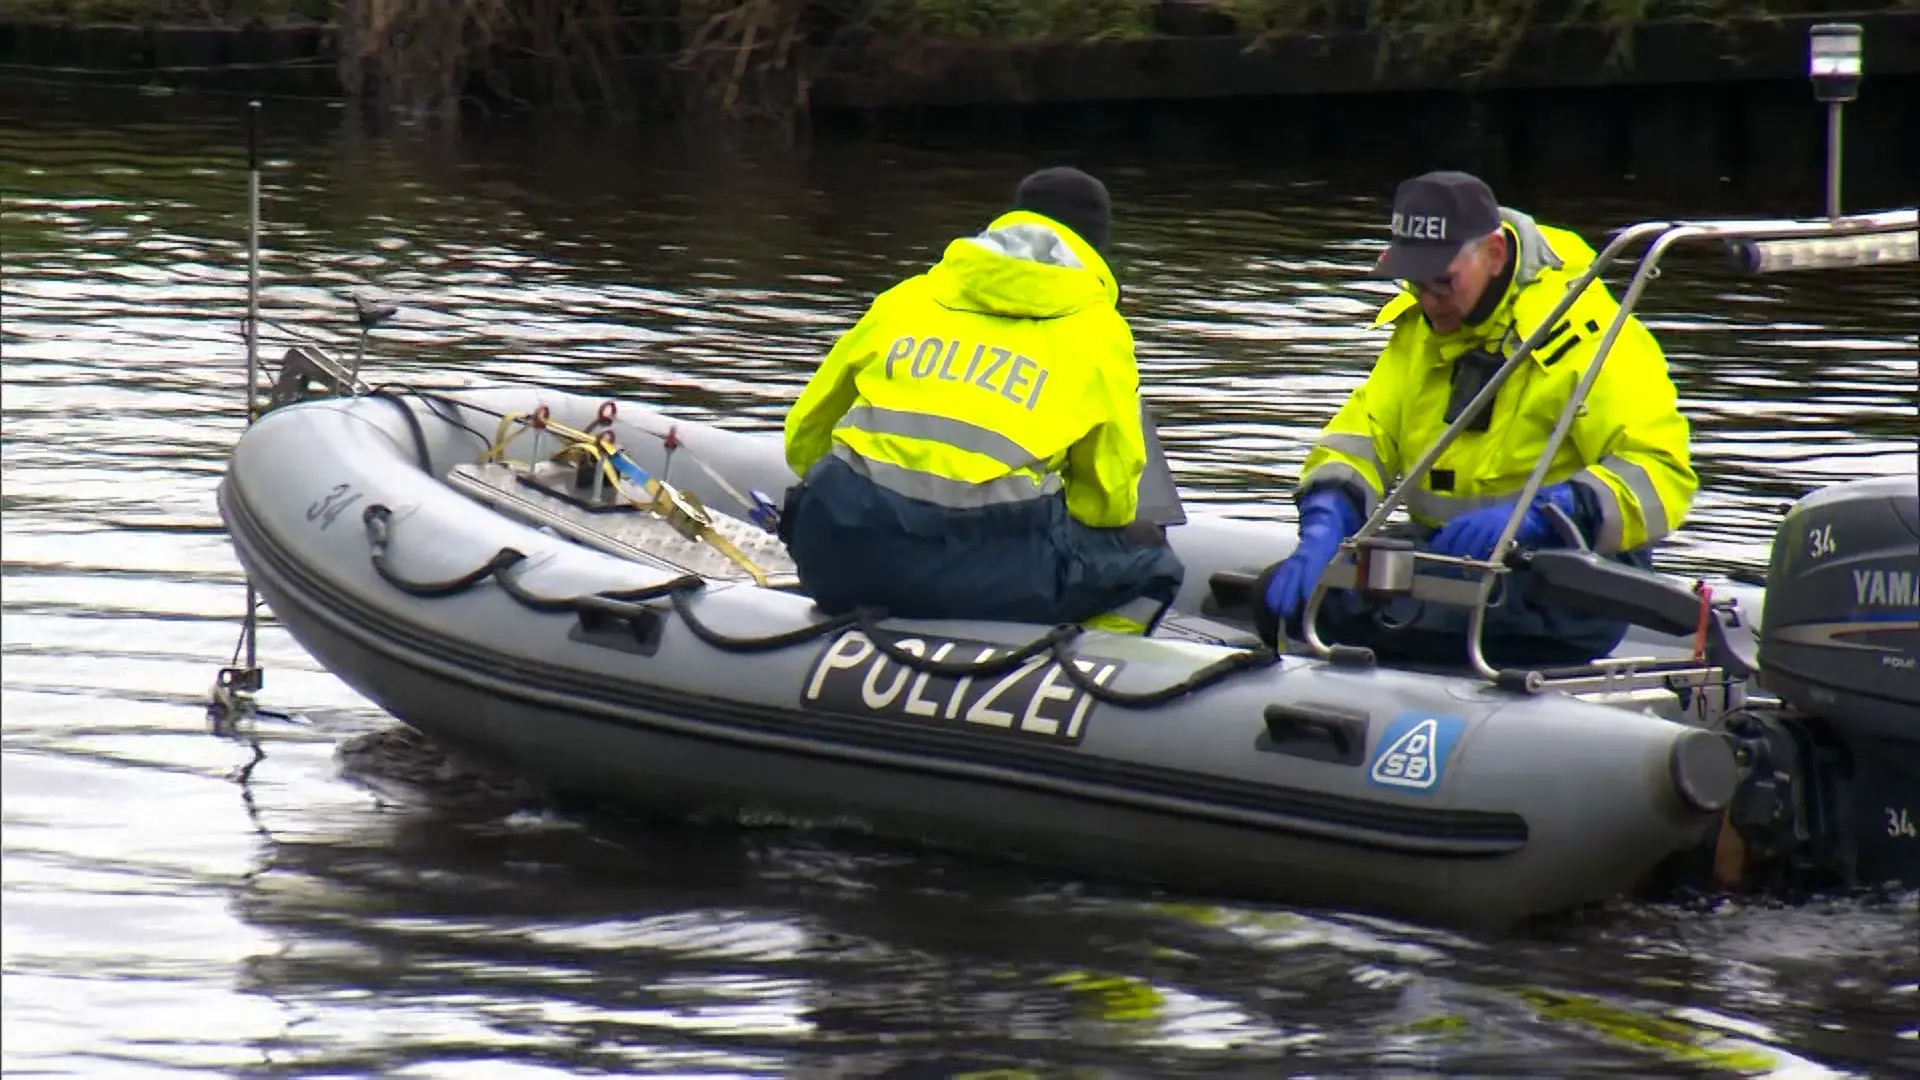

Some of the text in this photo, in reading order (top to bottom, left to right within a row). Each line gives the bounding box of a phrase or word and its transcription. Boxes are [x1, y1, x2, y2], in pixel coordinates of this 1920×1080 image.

[1391, 212, 1447, 240] OLIZEI
[885, 336, 1049, 411] POLIZEI
[306, 483, 364, 532] 34
[1808, 523, 1837, 558] 34
[807, 630, 1116, 738] POLIZEI
[1405, 734, 1428, 754] D
[1384, 753, 1428, 778] SB
[1886, 806, 1917, 838] 34
